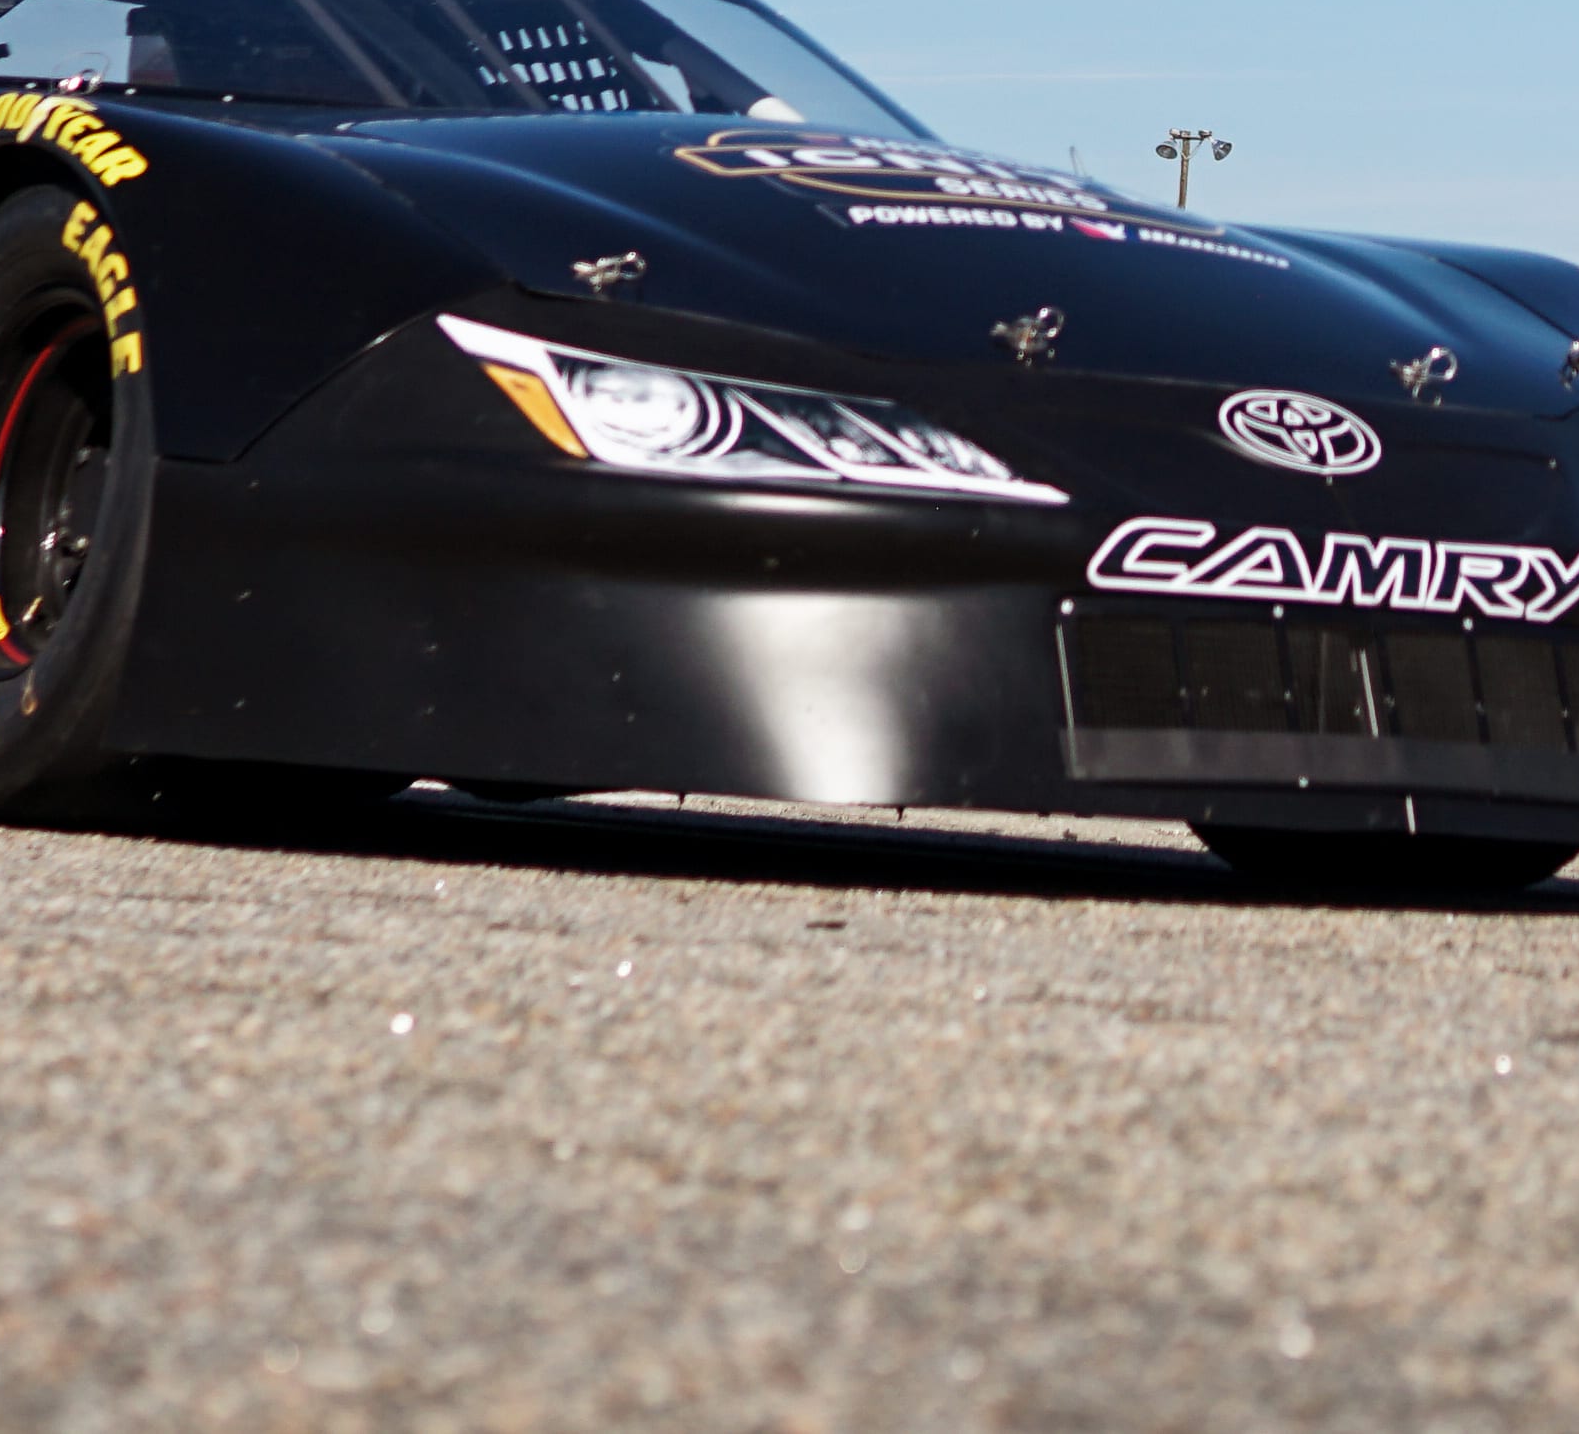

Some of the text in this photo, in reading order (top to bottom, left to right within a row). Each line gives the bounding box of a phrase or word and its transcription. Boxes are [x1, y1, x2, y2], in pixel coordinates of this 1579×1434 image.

[934, 175, 1109, 212] SERIES
[848, 204, 1064, 232] POWERED BY
[63, 199, 142, 379] EAGLE
